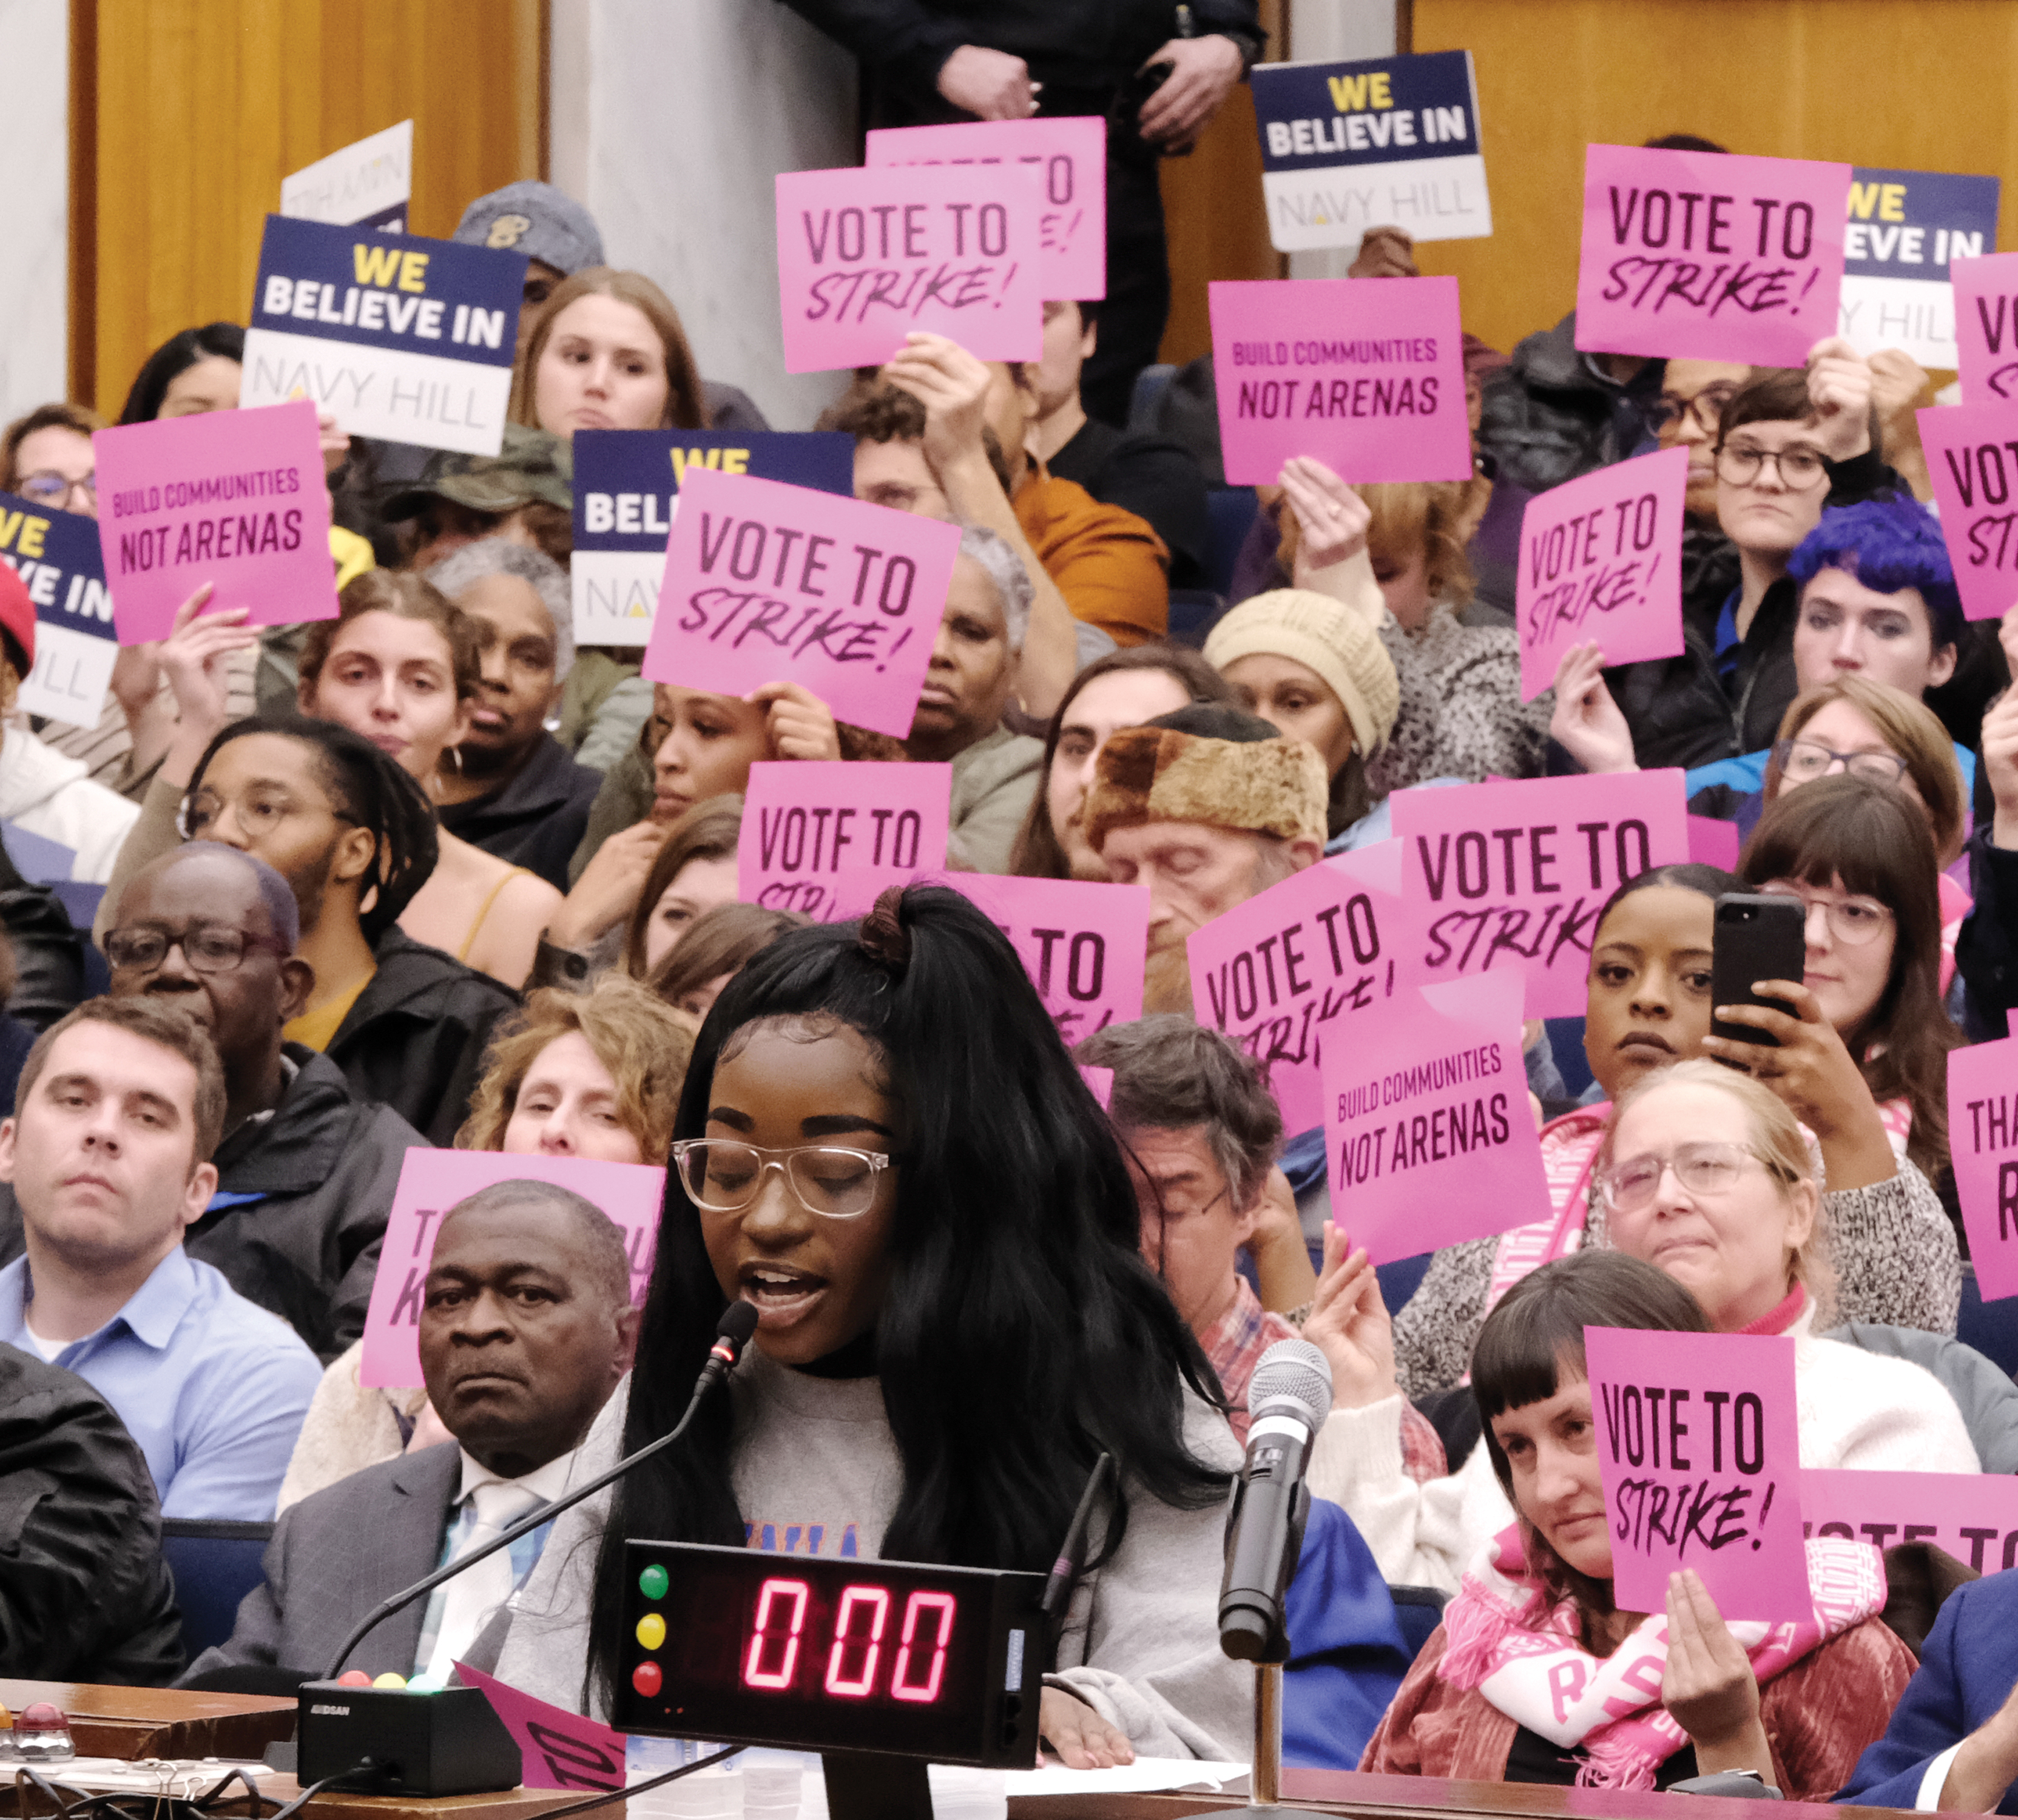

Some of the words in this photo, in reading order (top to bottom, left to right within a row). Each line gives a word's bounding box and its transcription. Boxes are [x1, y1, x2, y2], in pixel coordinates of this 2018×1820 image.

[1328, 72, 1393, 112] WE
[1266, 110, 1417, 157] BELIEVE
[1423, 106, 1467, 143] IN
[801, 204, 927, 264] VOTE
[946, 203, 1008, 257] TO
[1277, 187, 1375, 229] NAVY
[1391, 179, 1475, 218] HILL
[1608, 185, 1734, 254] VOTE
[1752, 197, 1815, 261] TO
[352, 243, 430, 293] WE
[1934, 228, 1984, 266] IN
[262, 275, 445, 340] BELIEVE
[451, 305, 506, 349] IN
[805, 261, 1019, 324] STRIKE!
[1601, 256, 1820, 318] STRIKE!
[1232, 340, 1290, 367] BUILD
[1294, 337, 1438, 366] COMMUNITIES
[1878, 301, 1952, 342] HIL
[252, 354, 376, 402] NAVY
[390, 375, 488, 430] HILL
[1238, 380, 1300, 420] NOT
[1305, 376, 1440, 419] ARENAS
[113, 487, 160, 518] BUILD
[164, 467, 300, 510] COMMUNITIES
[121, 525, 171, 575] NOT
[175, 508, 303, 565] ARENAS
[700, 511, 836, 596] VOTE
[852, 545, 917, 617] TO
[1532, 507, 1603, 590] VOTE
[1615, 493, 1658, 556] TO
[64, 574, 114, 623] IN
[678, 587, 914, 673] STRIKE!
[1527, 551, 1661, 647] STRIKE!
[870, 809, 922, 868] TO
[1417, 826, 1557, 901] VOTE
[1578, 819, 1652, 890] TO
[1031, 928, 1105, 1002] TO
[1206, 922, 1313, 1031] VOTE
[1315, 892, 1381, 976] TO
[1337, 1082, 1379, 1123] BUILD
[1383, 1042, 1503, 1107] COMMUNITIES
[1339, 1127, 1388, 1191] NOT
[1391, 1093, 1510, 1171] ARENAS
[1602, 1383, 1690, 1471] VOTE
[1704, 1390, 1764, 1475] TO
[1615, 1478, 1776, 1560] STRIKE!
